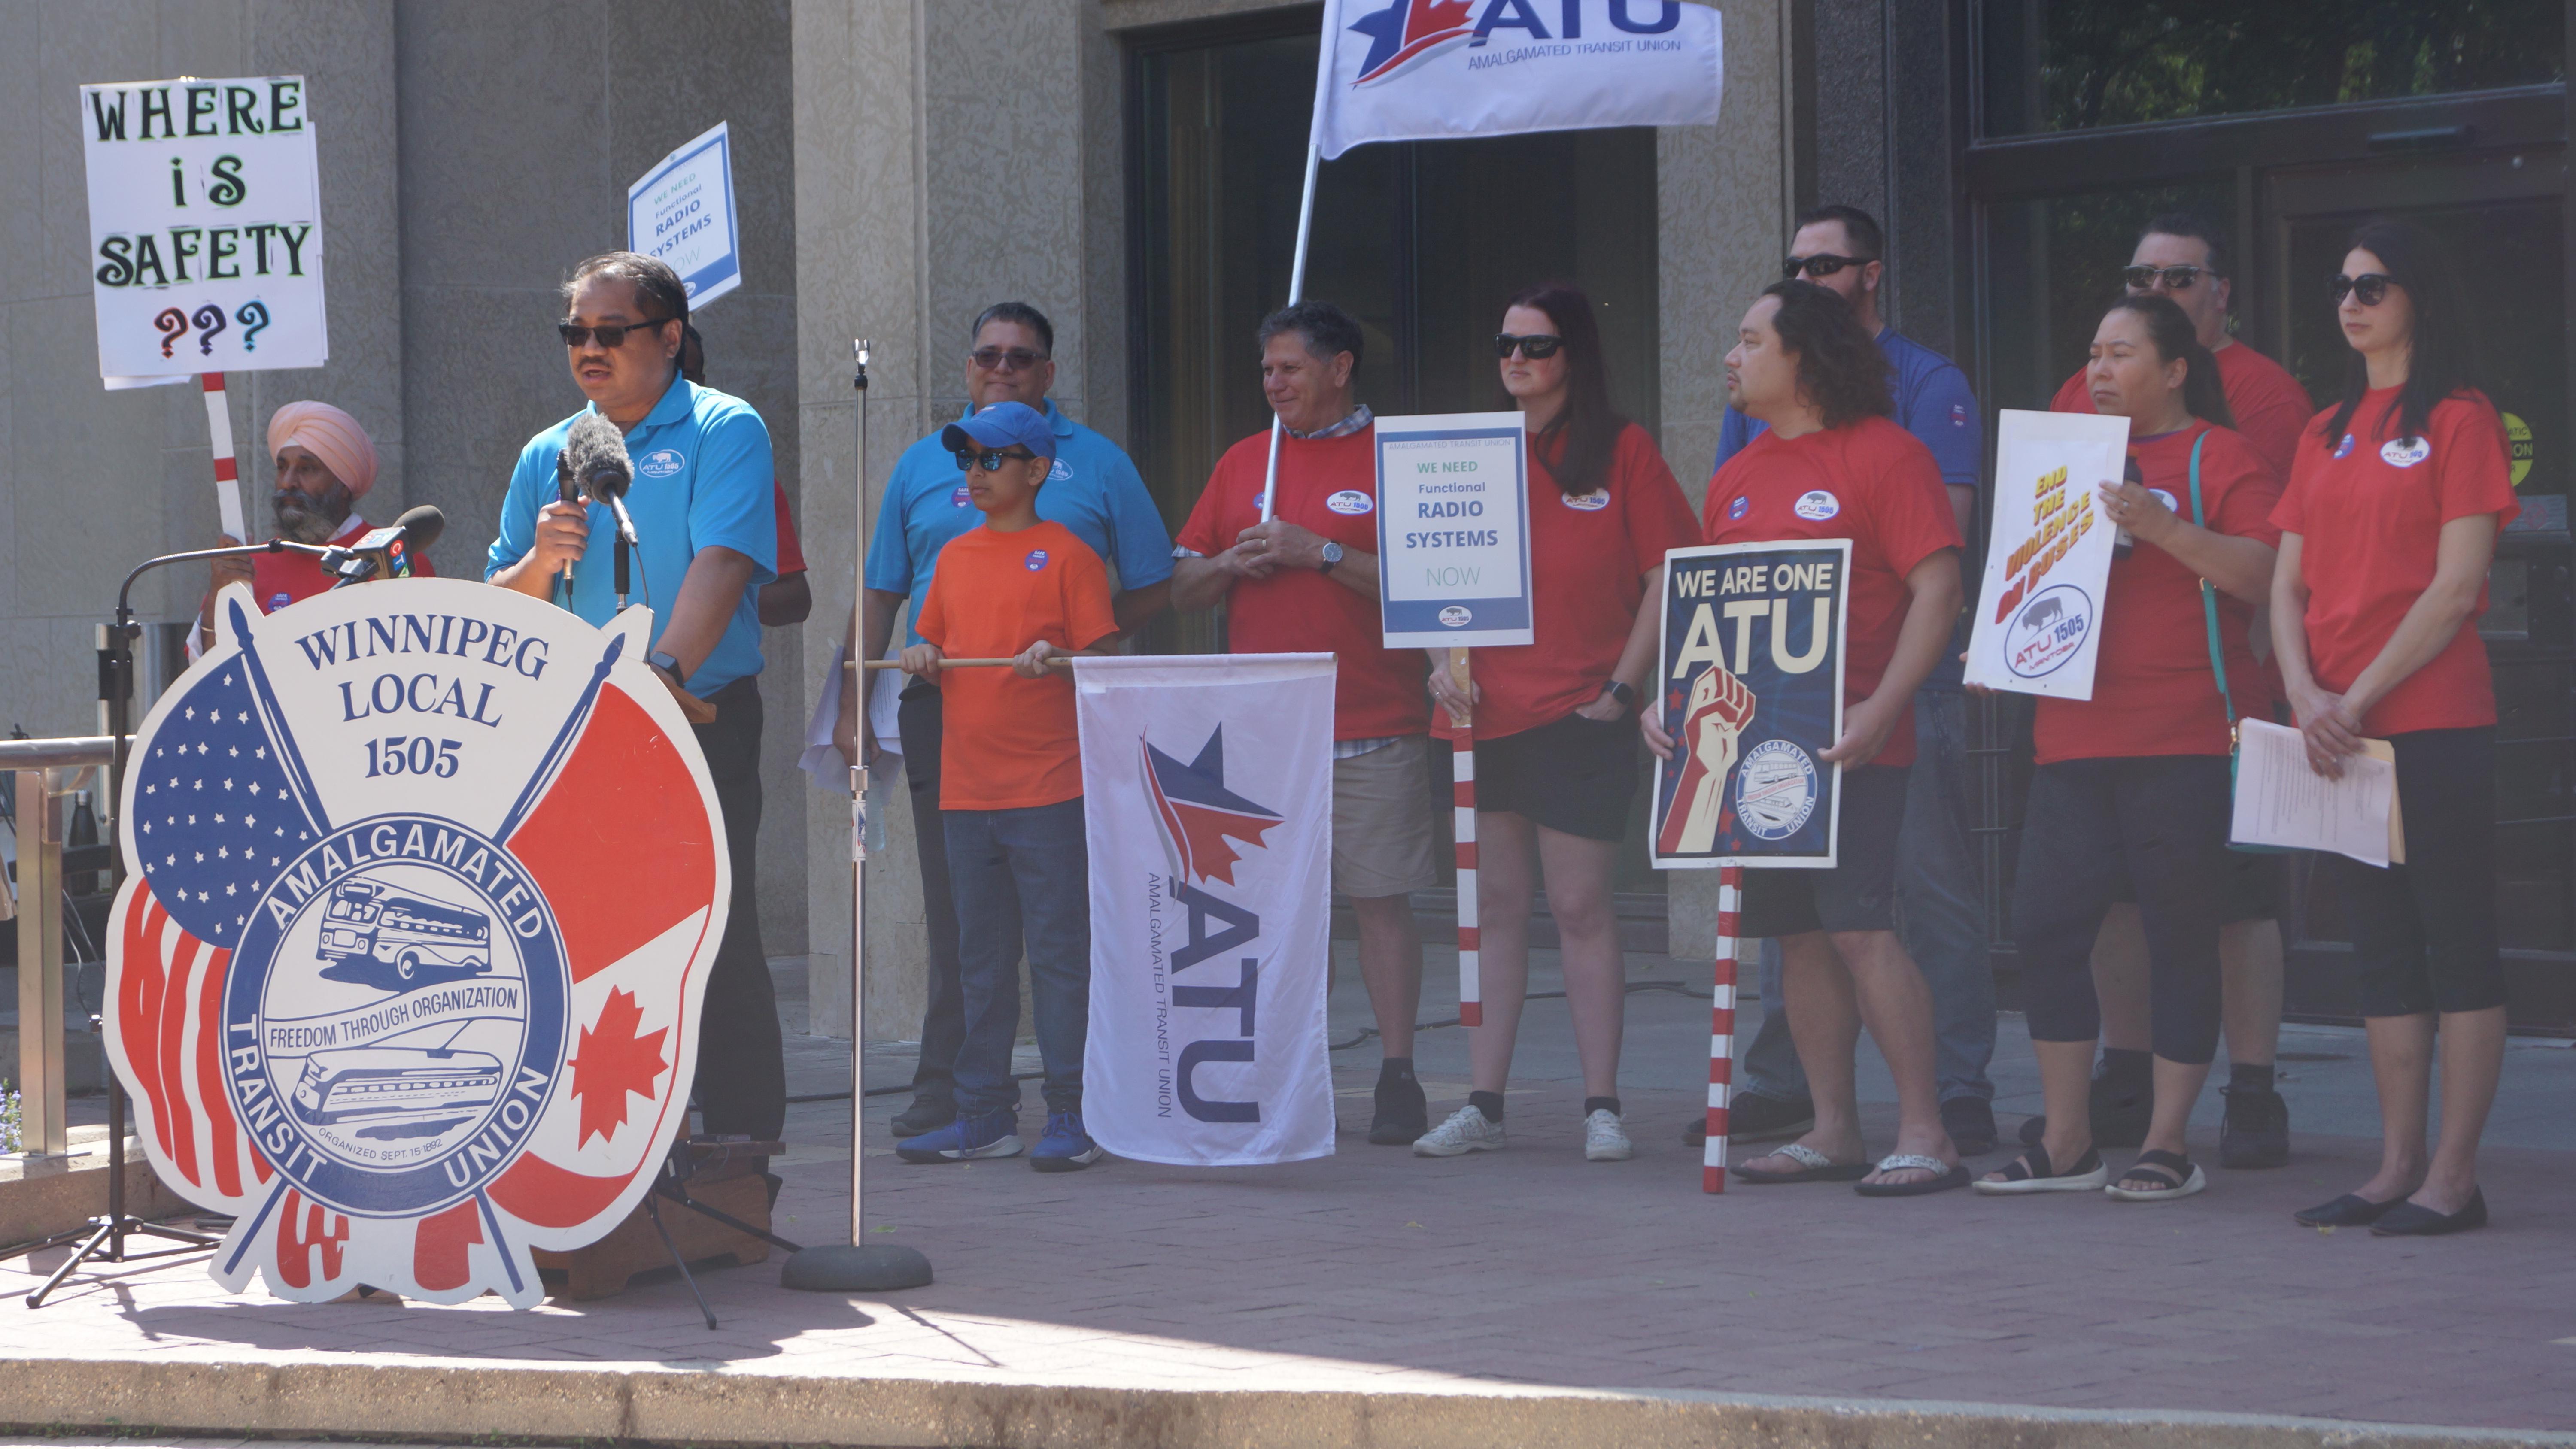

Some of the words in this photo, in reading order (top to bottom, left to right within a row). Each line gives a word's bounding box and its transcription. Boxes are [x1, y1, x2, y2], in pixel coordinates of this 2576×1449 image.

[1467, 44, 1571, 70] AMALGAMATED
[1576, 40, 1632, 55] TRANSIT
[1637, 39, 1681, 52] UNION
[90, 81, 303, 142] WHERE
[654, 190, 668, 205] WE
[671, 172, 696, 193] NEED
[656, 183, 702, 219] Functional
[656, 199, 701, 237] RADIO
[96, 223, 312, 287] SAFETY
[670, 246, 700, 272] OW
[1388, 440, 1447, 450] AMALGAMATED
[1449, 439, 1483, 448] TRANSIT
[1485, 438, 1511, 446] UNION
[1417, 462, 1437, 473] WE
[1443, 461, 1478, 473] NEED
[2035, 465, 2067, 500] END
[1353, 501, 1368, 510] 1505
[1419, 482, 1486, 494] Functional
[1590, 497, 1605, 505] 1505
[1418, 500, 1484, 518] RADIO
[1818, 506, 1834, 514] 1505
[2033, 488, 2065, 527] THE
[1406, 530, 1498, 549] SYSTEMS
[2005, 490, 2091, 581] VIOLENCE
[2027, 509, 2094, 594] BUSES
[1426, 566, 1481, 587] NOW
[1676, 569, 1717, 598] WE
[1720, 565, 1768, 596] ARE
[1773, 563, 1834, 592] ONE
[294, 614, 549, 681] WINNIPEG
[1671, 597, 1831, 679] ATU
[2014, 634, 2052, 669] ATU
[2054, 613, 2084, 643] 1505
[338, 673, 503, 728] LOCAL
[364, 735, 463, 778] 1505
[1741, 741, 1813, 778] AMALGAMATED
[1737, 796, 1768, 836] TRANSIT
[1786, 796, 1815, 833] UNION
[267, 824, 543, 939] AMALGAMATED
[1148, 872, 1165, 994] AMALGAMATED
[270, 1024, 337, 1048] FREEDOM
[340, 1005, 410, 1042] THROUGH
[412, 987, 518, 1019] ORGANIZATION
[1168, 875, 1261, 1123] ATU
[1156, 997, 1170, 1064] TRANSIT
[229, 1013, 328, 1184] TRANSIT
[1157, 1069, 1172, 1119] UNION
[319, 1127, 377, 1159] ORGANIZED
[444, 1065, 550, 1188] UNION
